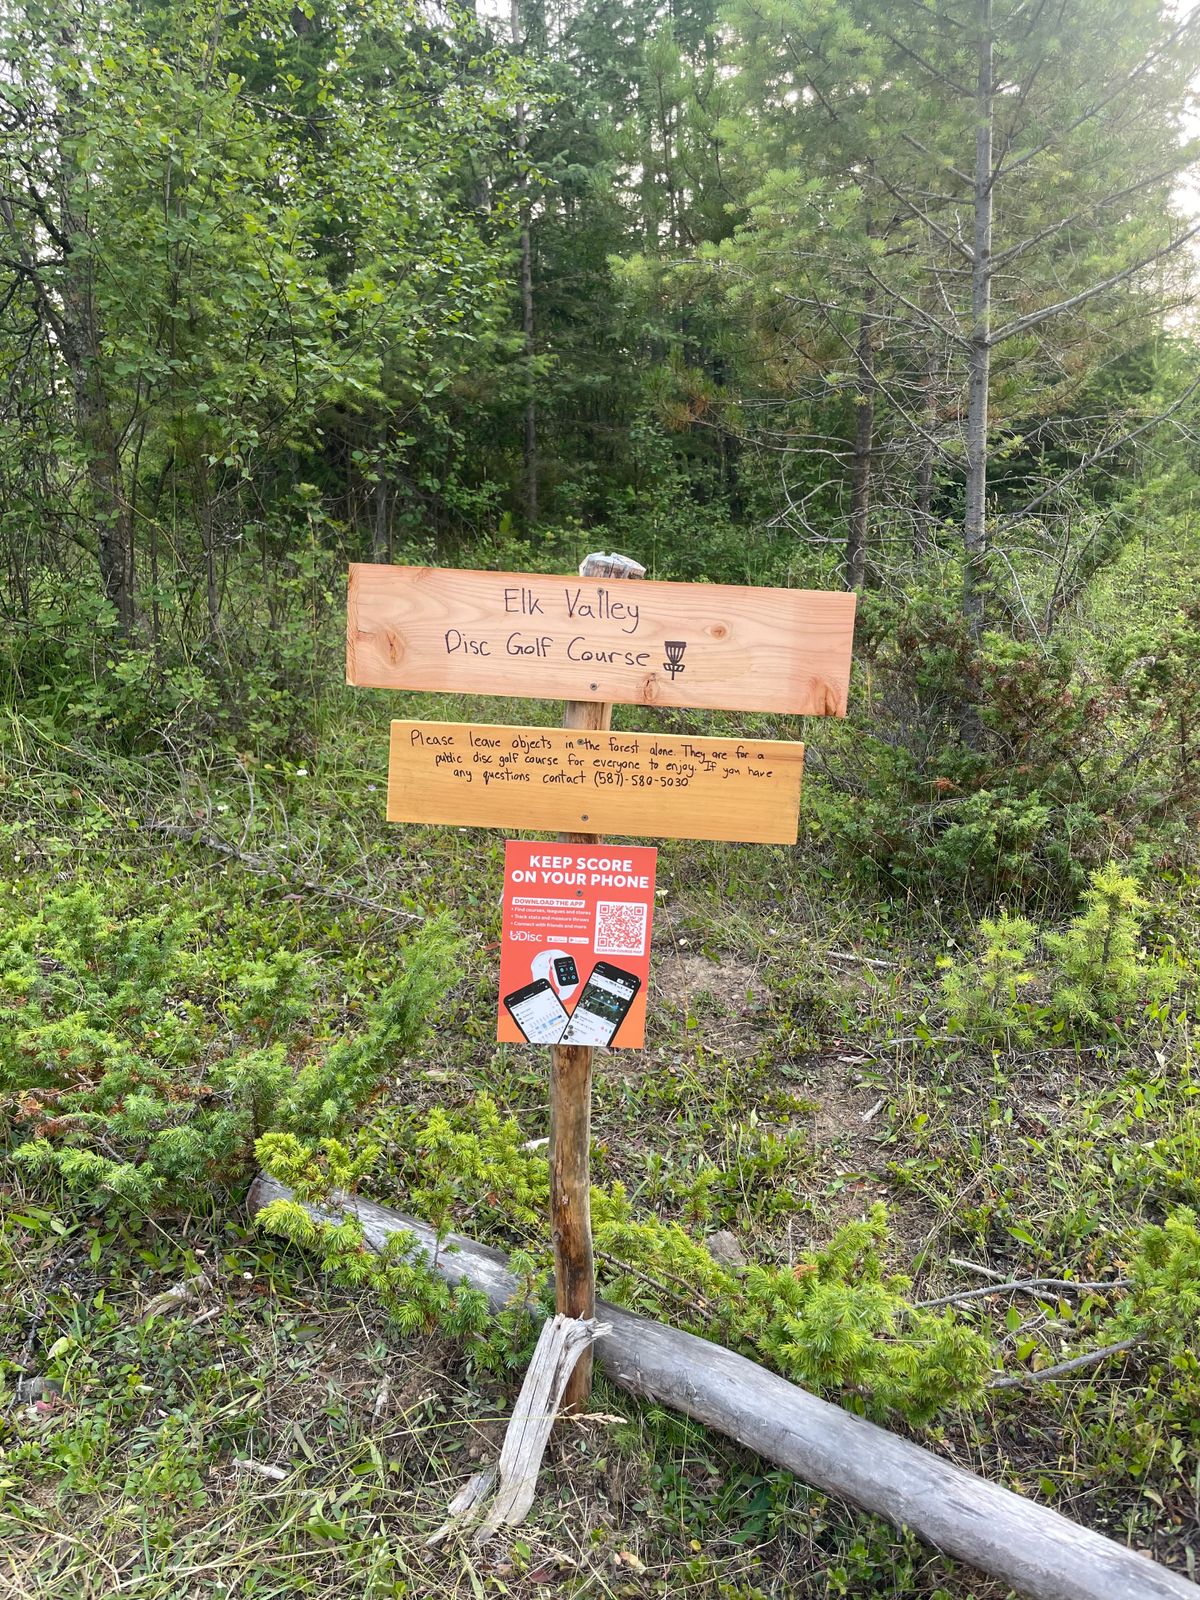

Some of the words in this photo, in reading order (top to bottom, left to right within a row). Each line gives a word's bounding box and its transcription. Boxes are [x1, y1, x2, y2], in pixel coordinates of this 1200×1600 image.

[504, 588, 544, 615] Elk
[565, 588, 639, 633] Valley
[444, 629, 491, 656] Disc
[506, 632, 553, 657] Golf
[567, 636, 651, 667] Course
[410, 729, 455, 747] Please
[469, 731, 500, 748] leave
[511, 734, 552, 754] objects
[565, 736, 574, 749] in
[582, 737, 600, 751] the
[608, 737, 640, 753] forest
[650, 742, 676, 756] alone.
[681, 744, 705, 763] They
[712, 751, 728, 760] are
[736, 746, 749, 759] for
[435, 751, 462, 767] public
[473, 752, 493, 764] disc
[499, 752, 519, 767] golf
[524, 755, 558, 766] course
[568, 753, 585, 766] for
[593, 758, 640, 773] everyone
[649, 758, 659, 770] to
[666, 760, 697, 778] enjoy.
[703, 760, 717, 772] If
[723, 766, 740, 779] you
[748, 766, 773, 778] have
[453, 769, 472, 782] any
[482, 768, 530, 785] questions
[542, 770, 586, 785] contact
[529, 855, 572, 869] KEEP
[575, 857, 633, 872] SCORE
[511, 870, 536, 883] ON
[541, 871, 586, 886] YOUR
[591, 874, 649, 888] PHONE
[514, 898, 554, 906] DOWNLOAD
[509, 930, 542, 942] UDisc
